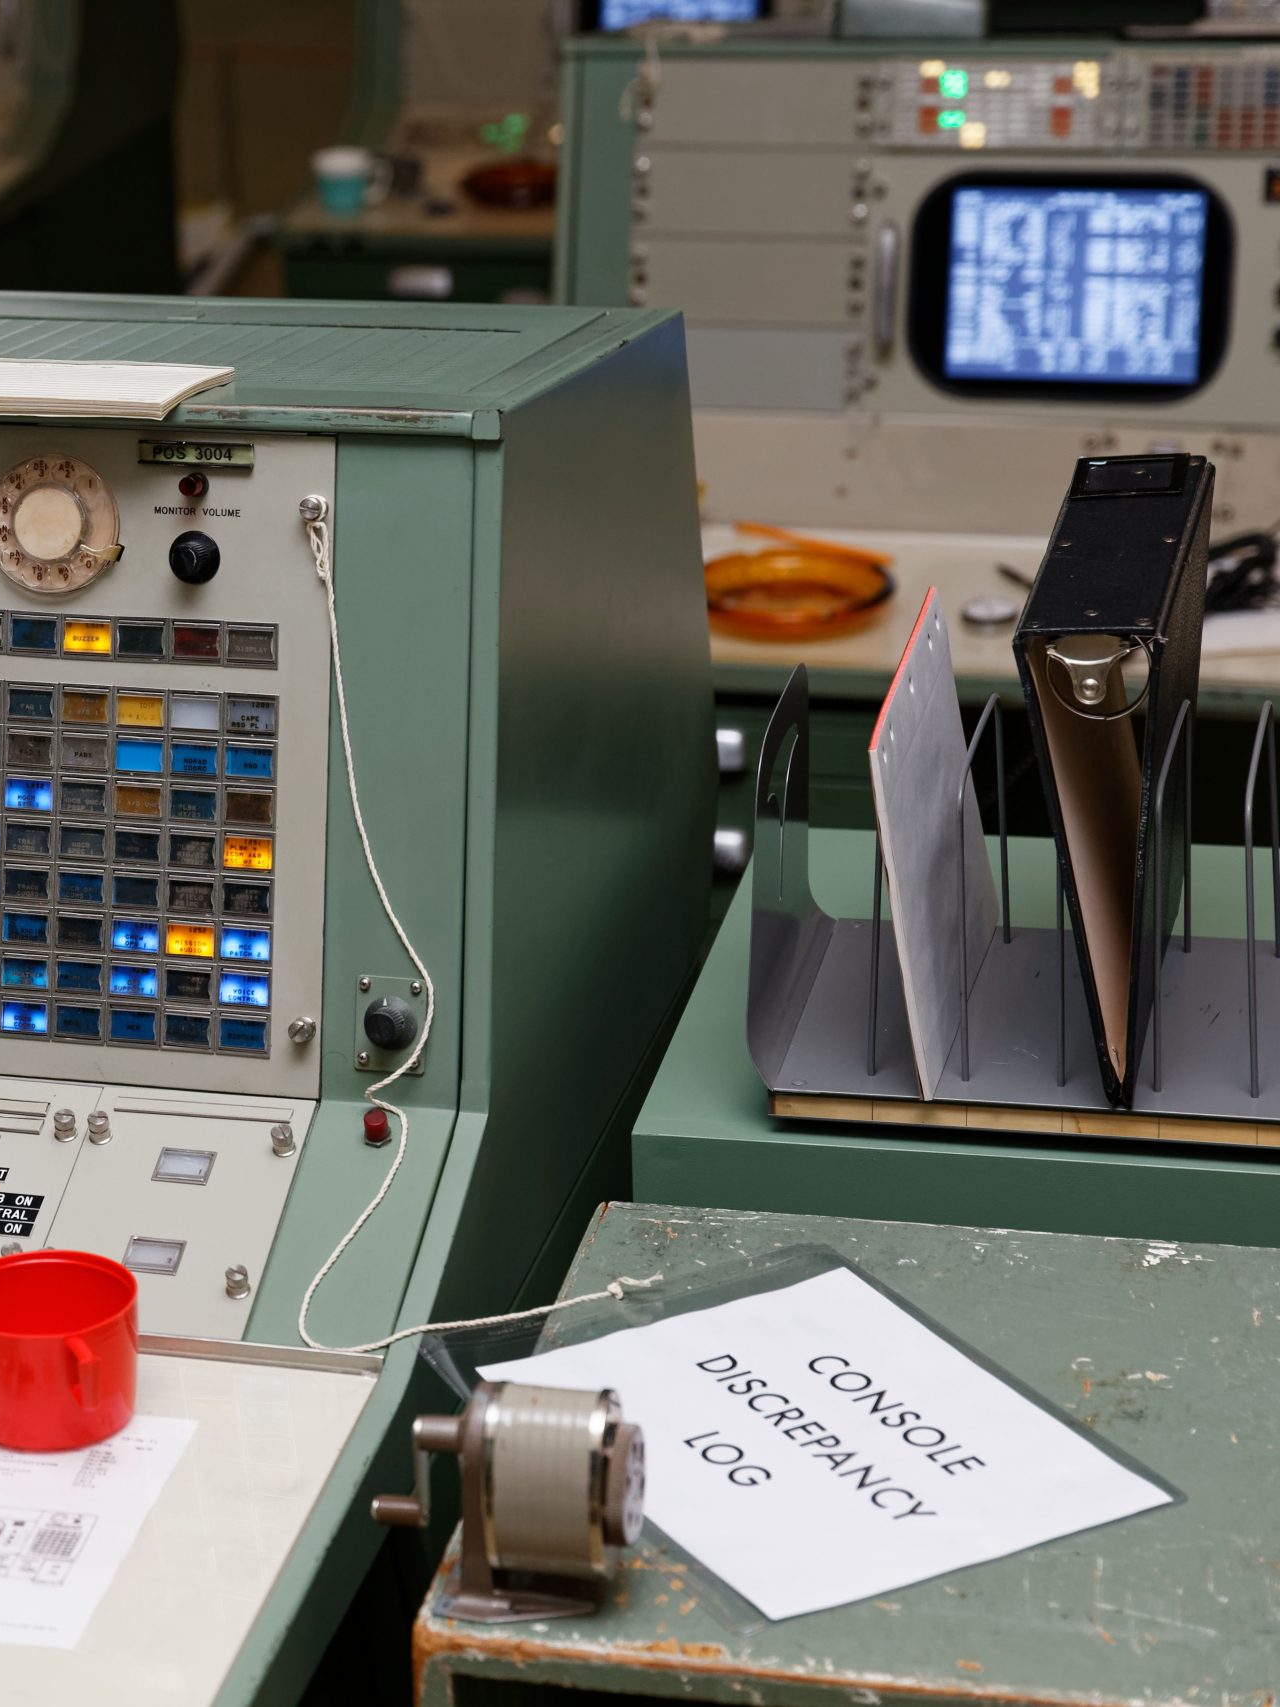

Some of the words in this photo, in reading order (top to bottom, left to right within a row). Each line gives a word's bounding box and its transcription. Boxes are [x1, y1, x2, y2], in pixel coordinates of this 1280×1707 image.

[152, 447, 186, 460] POS
[195, 448, 233, 461] 3004
[154, 507, 196, 515] MONITOR
[202, 508, 241, 518] VOLUME
[15, 1196, 33, 1206] ON
[4, 1223, 22, 1234] ON
[807, 1354, 986, 1477] CONSOLE
[696, 1353, 937, 1521] DISCREPANCY
[684, 1430, 771, 1487] LOG
